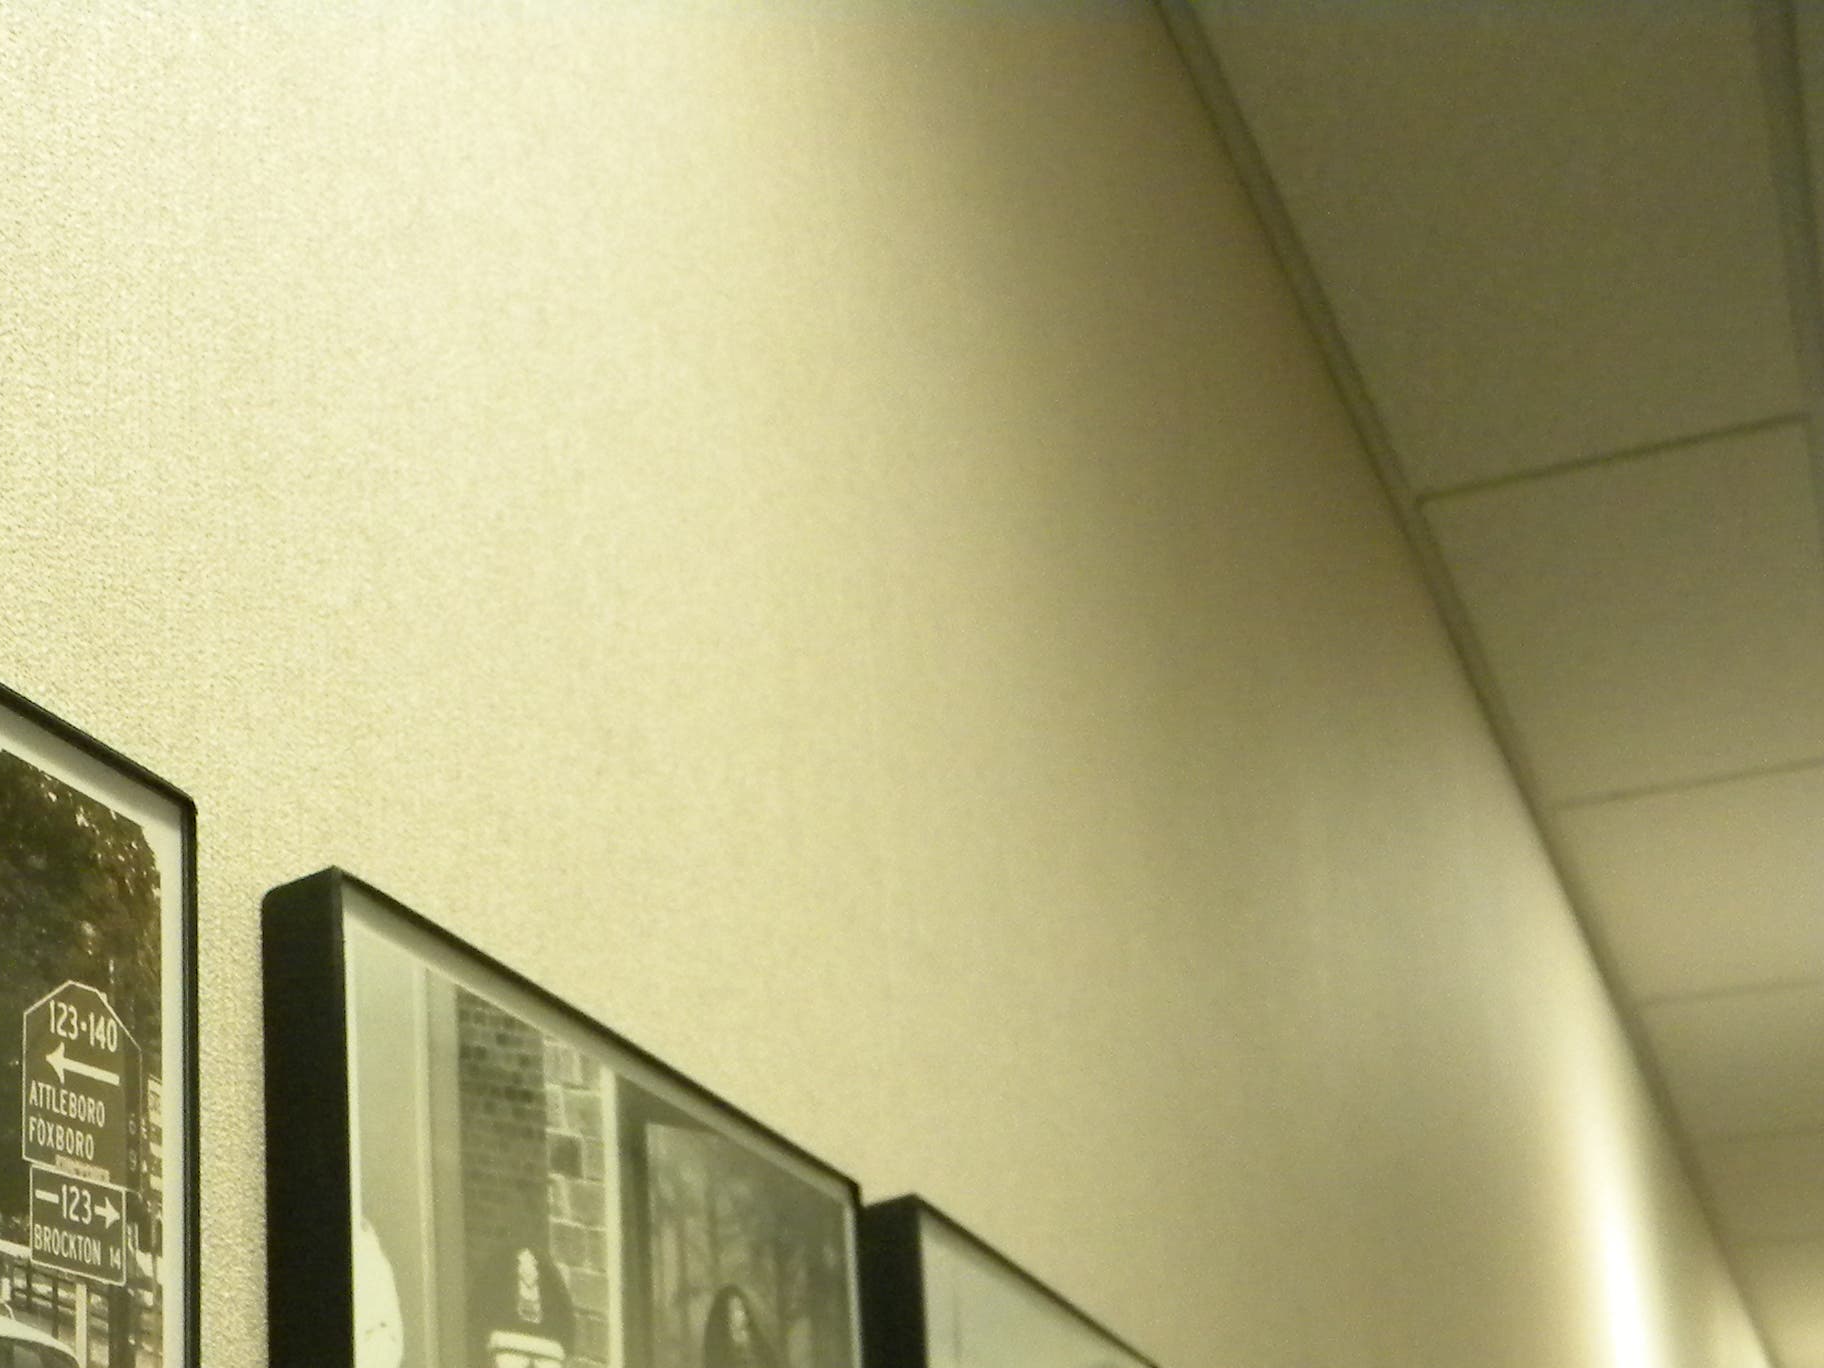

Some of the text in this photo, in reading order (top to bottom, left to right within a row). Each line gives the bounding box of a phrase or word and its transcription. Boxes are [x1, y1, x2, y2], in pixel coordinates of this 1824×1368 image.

[29, 1079, 105, 1128] ATTLEBORO
[29, 1115, 95, 1161] FOXBORO
[61, 1183, 92, 1225] 123
[34, 1223, 121, 1270] BROCKTON 14
